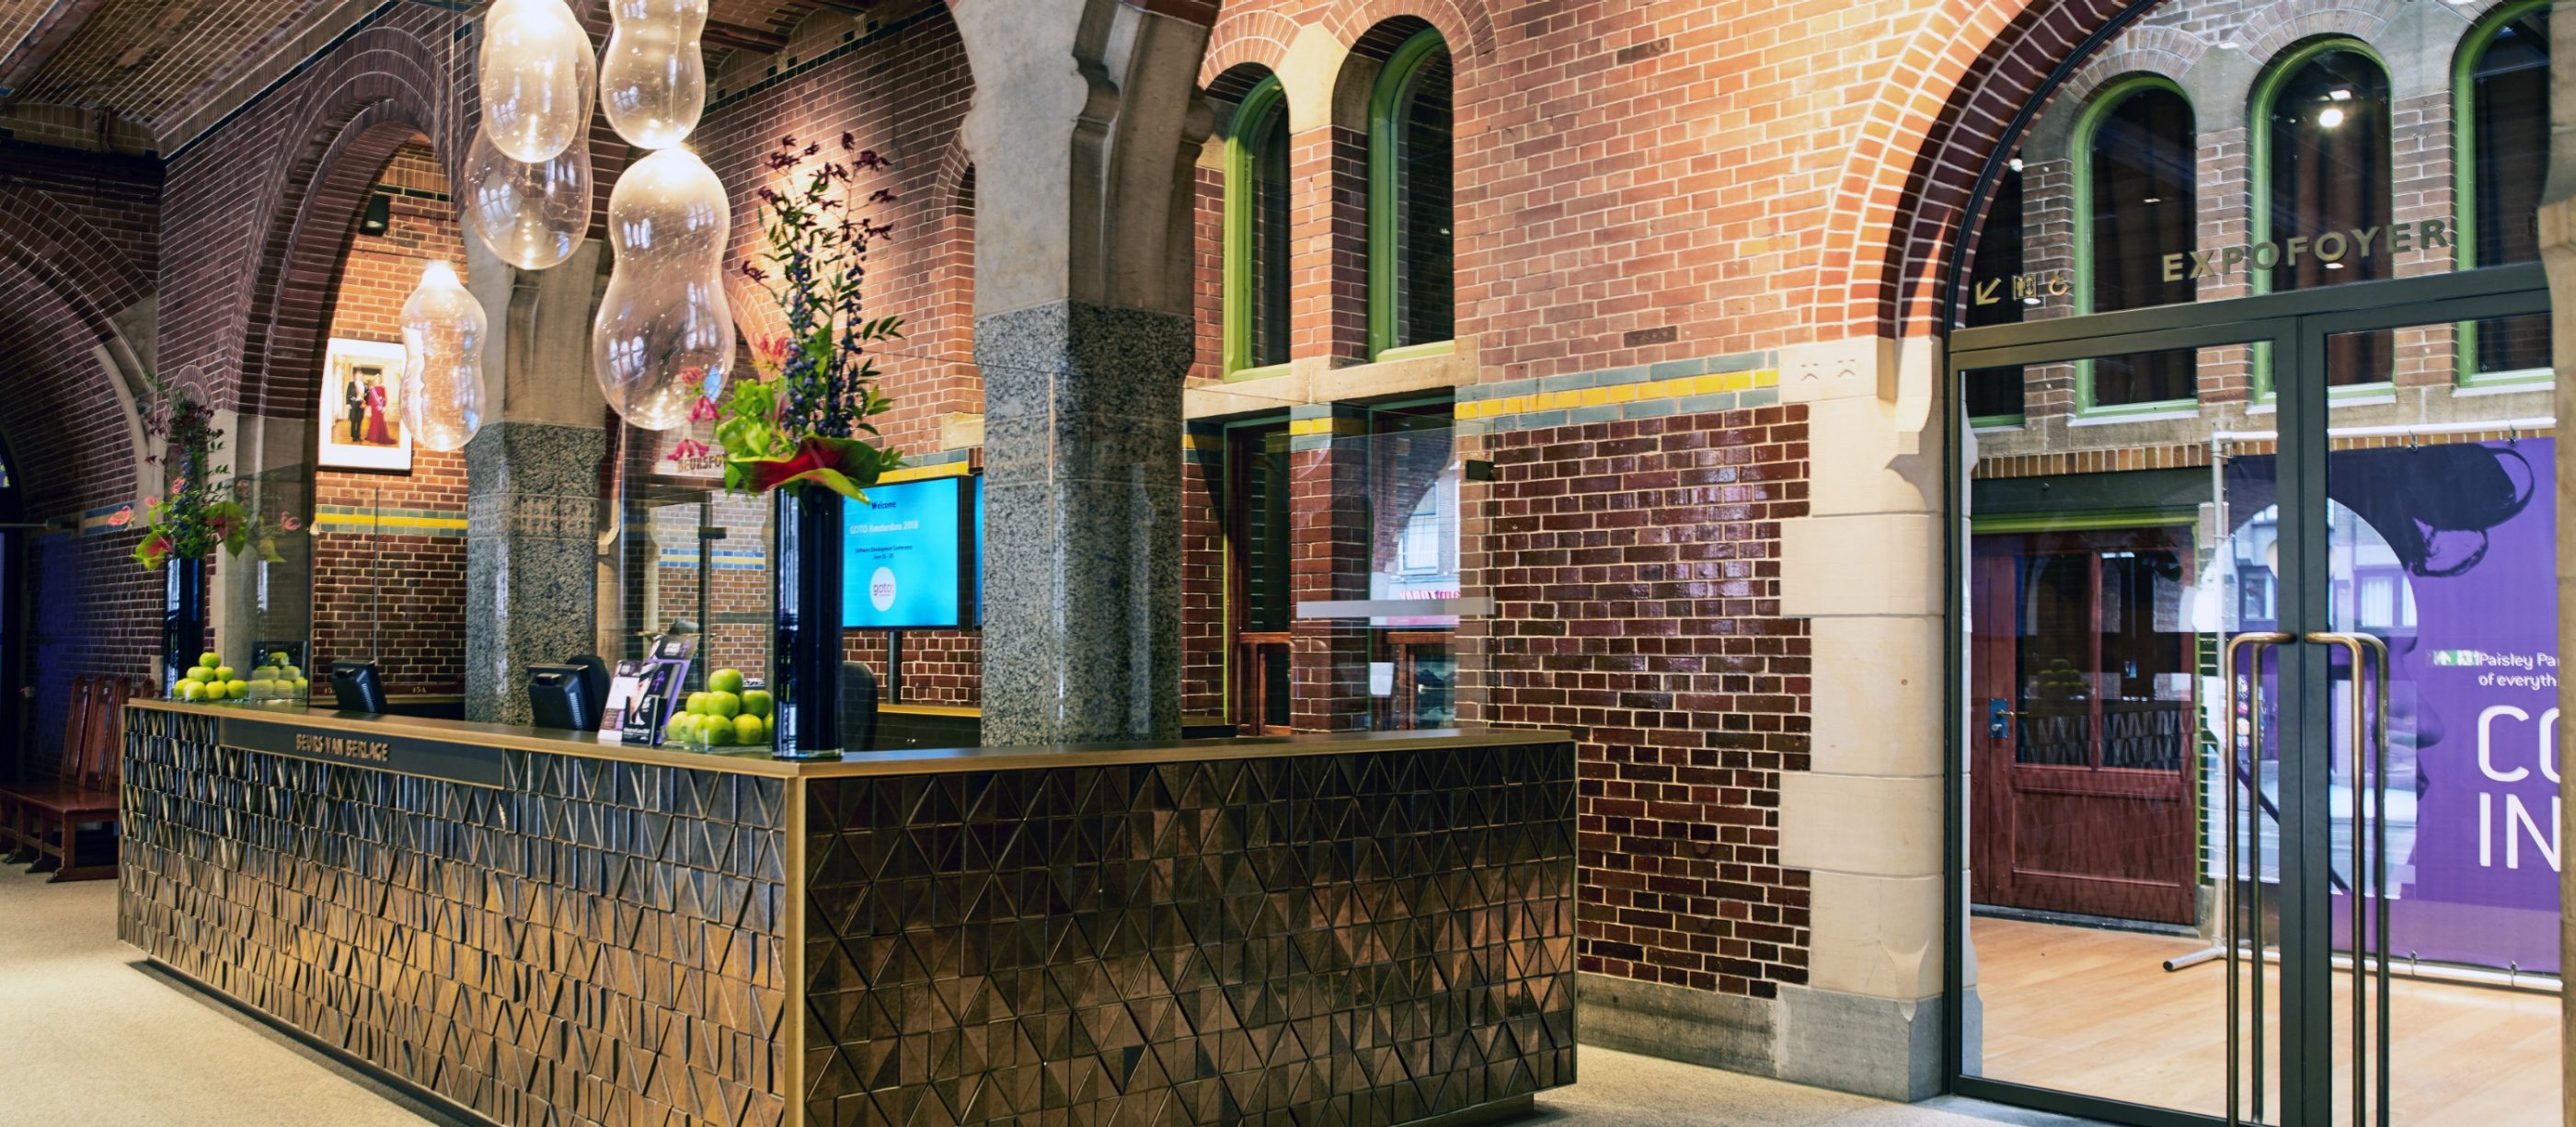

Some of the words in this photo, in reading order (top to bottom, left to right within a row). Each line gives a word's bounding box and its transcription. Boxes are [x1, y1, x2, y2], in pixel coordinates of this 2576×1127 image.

[2163, 219, 2450, 282] EXPOFOYER
[2479, 651, 2534, 671] Paisley
[2478, 673, 2494, 686] of
[296, 733, 324, 753] BEURS
[325, 737, 344, 754] VAN
[345, 739, 389, 762] BERLAGE
